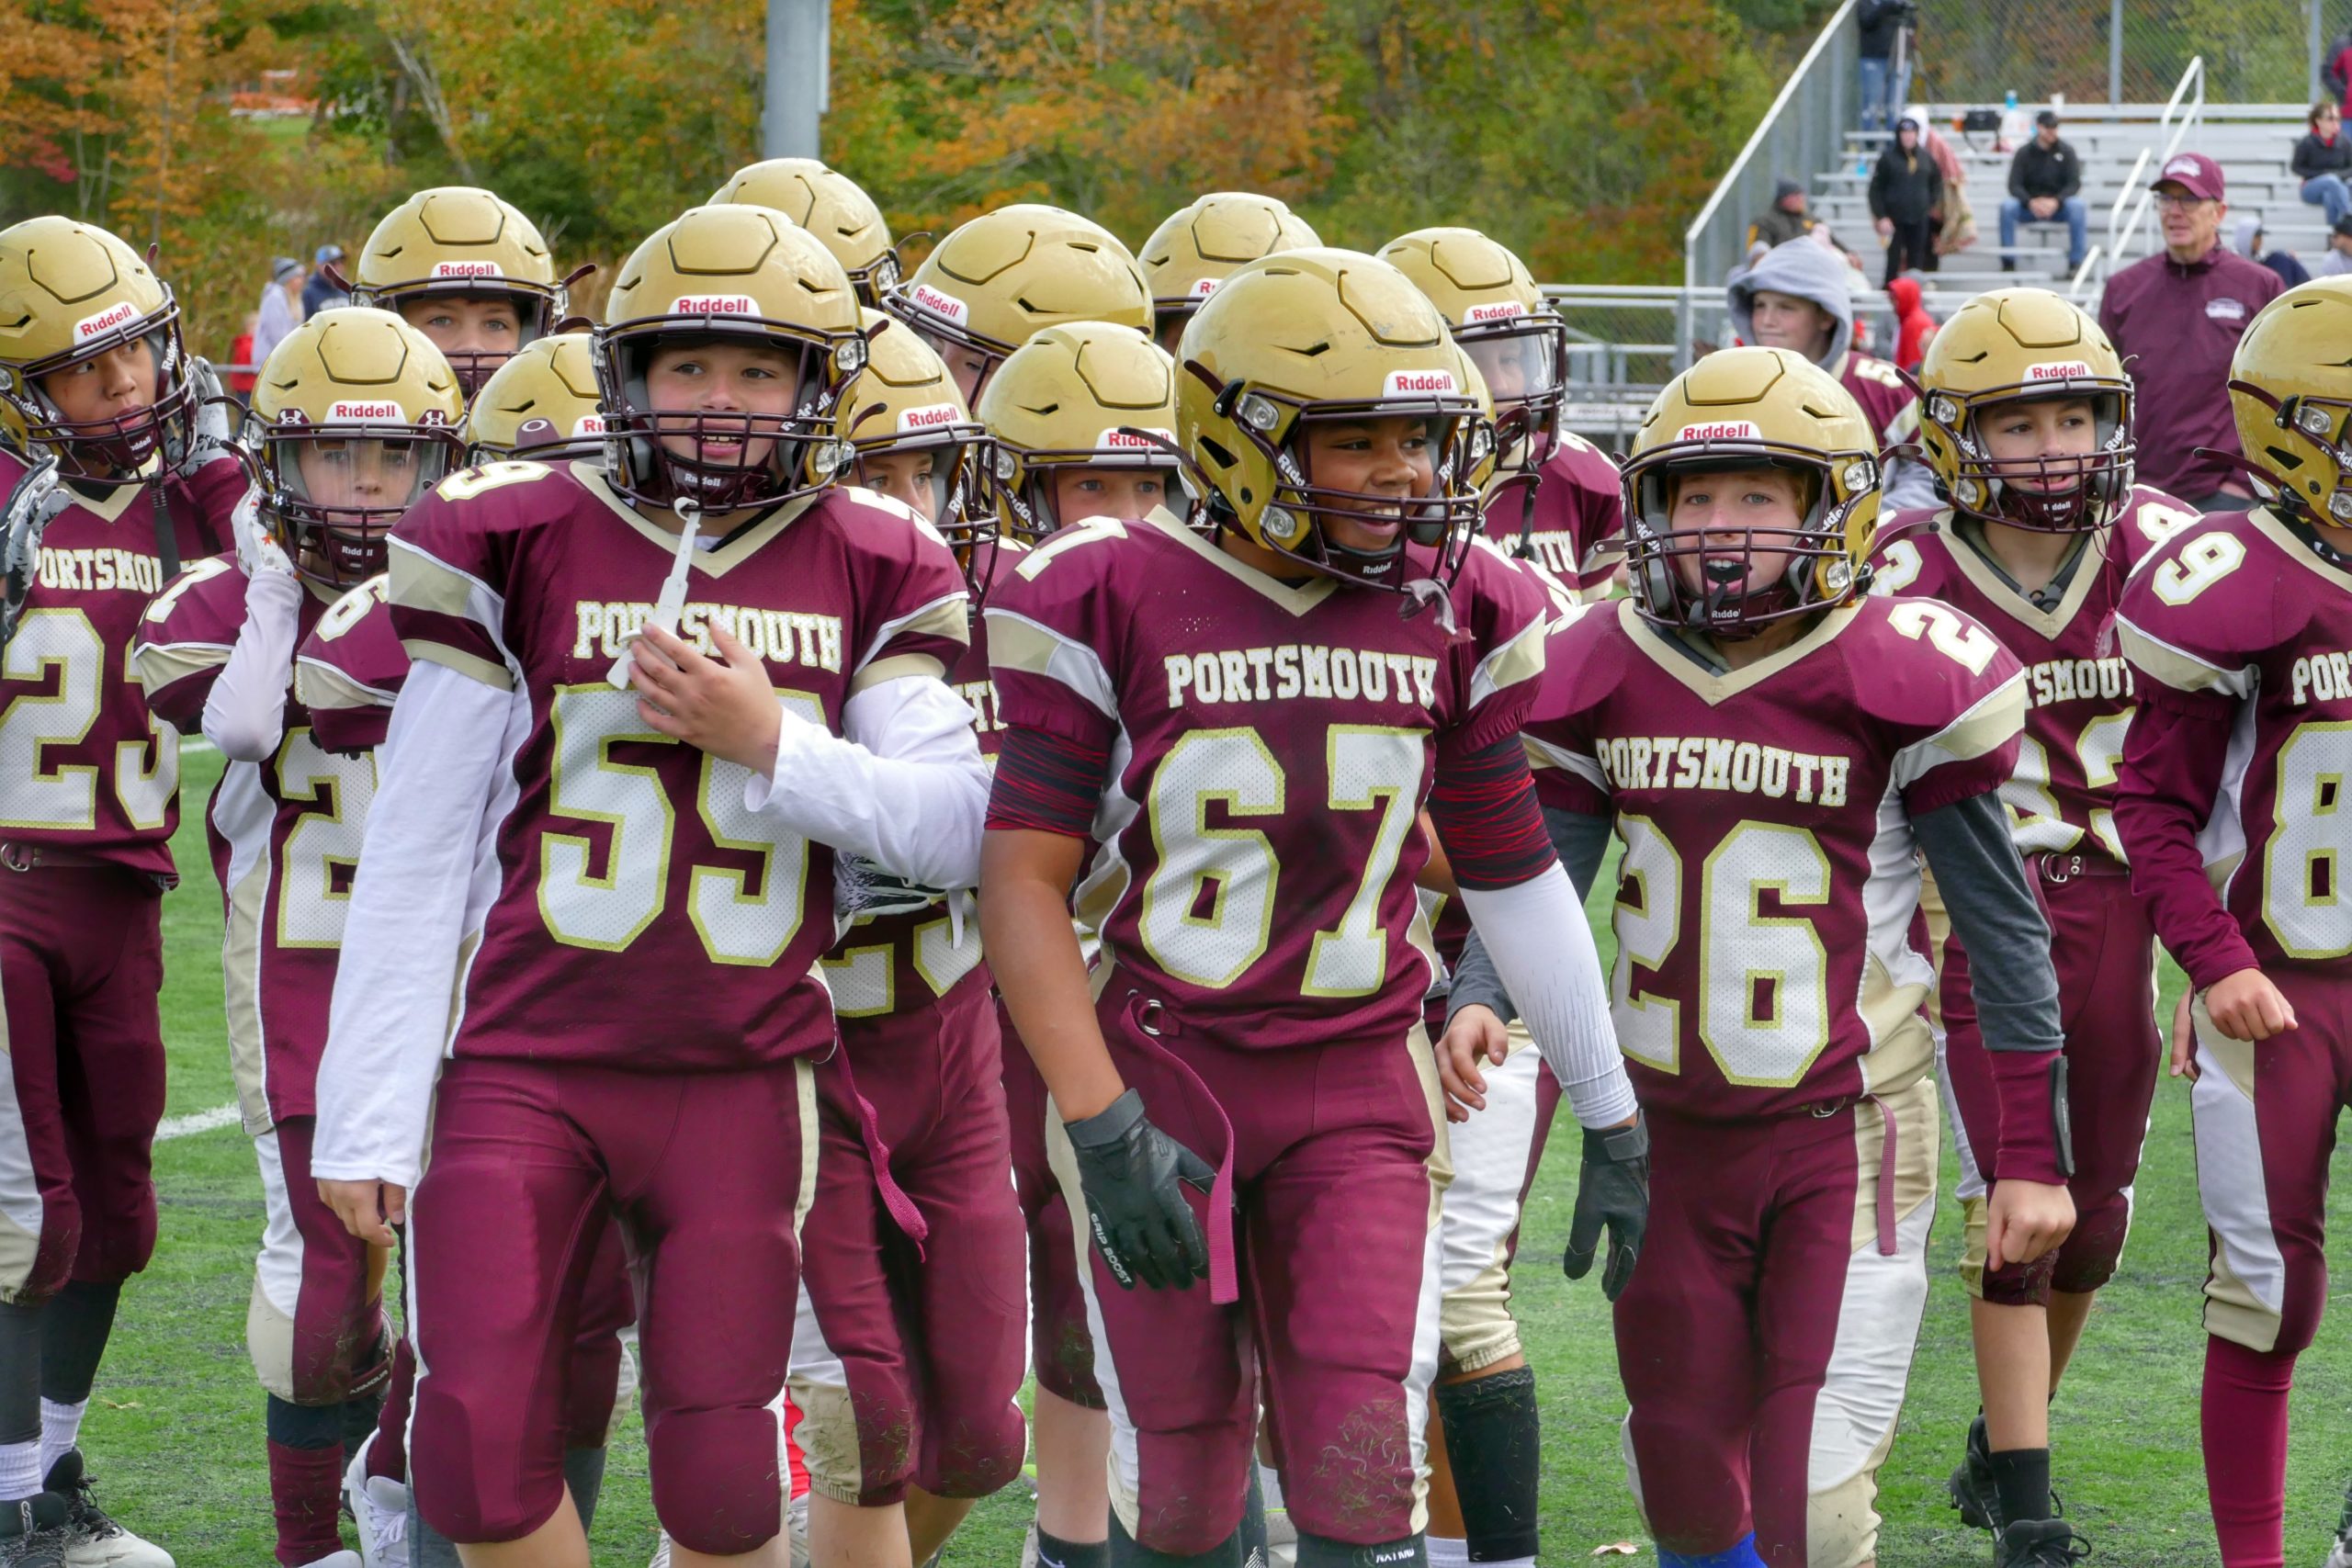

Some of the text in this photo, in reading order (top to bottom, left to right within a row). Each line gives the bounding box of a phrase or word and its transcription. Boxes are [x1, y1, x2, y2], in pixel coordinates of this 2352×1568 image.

[440, 265, 494, 276] Riddell
[679, 299, 748, 313] Riddell
[915, 286, 959, 318] Riddell
[1473, 305, 1522, 321] Riddell
[80, 304, 132, 336] Riddell
[1396, 375, 1451, 390] Riddell
[2032, 365, 2086, 378] Riddell
[336, 405, 396, 418] Riddell
[907, 407, 959, 427] Riddell
[130, 435, 152, 451] iddell
[1683, 423, 1749, 441] Riddell
[436, 460, 551, 502] 9
[2043, 502, 2071, 511] Rddell
[342, 546, 373, 557] Riddll
[1014, 515, 1128, 582] 7
[35, 547, 163, 593] ORTSMO
[1363, 561, 1392, 574] Riddell
[2152, 532, 2247, 606] 9
[146, 558, 232, 623] 7
[1712, 608, 1742, 618] Ridde
[573, 600, 842, 674] POSMOUTH
[1887, 602, 1999, 677] 2
[1164, 644, 1437, 709] PORTSMOUTH
[1596, 737, 1850, 807] PORTSMOUTH
[1137, 724, 1433, 998] 67
[1612, 809, 1831, 1089] 26
[1091, 1213, 1132, 1284] GRIP BOOST
